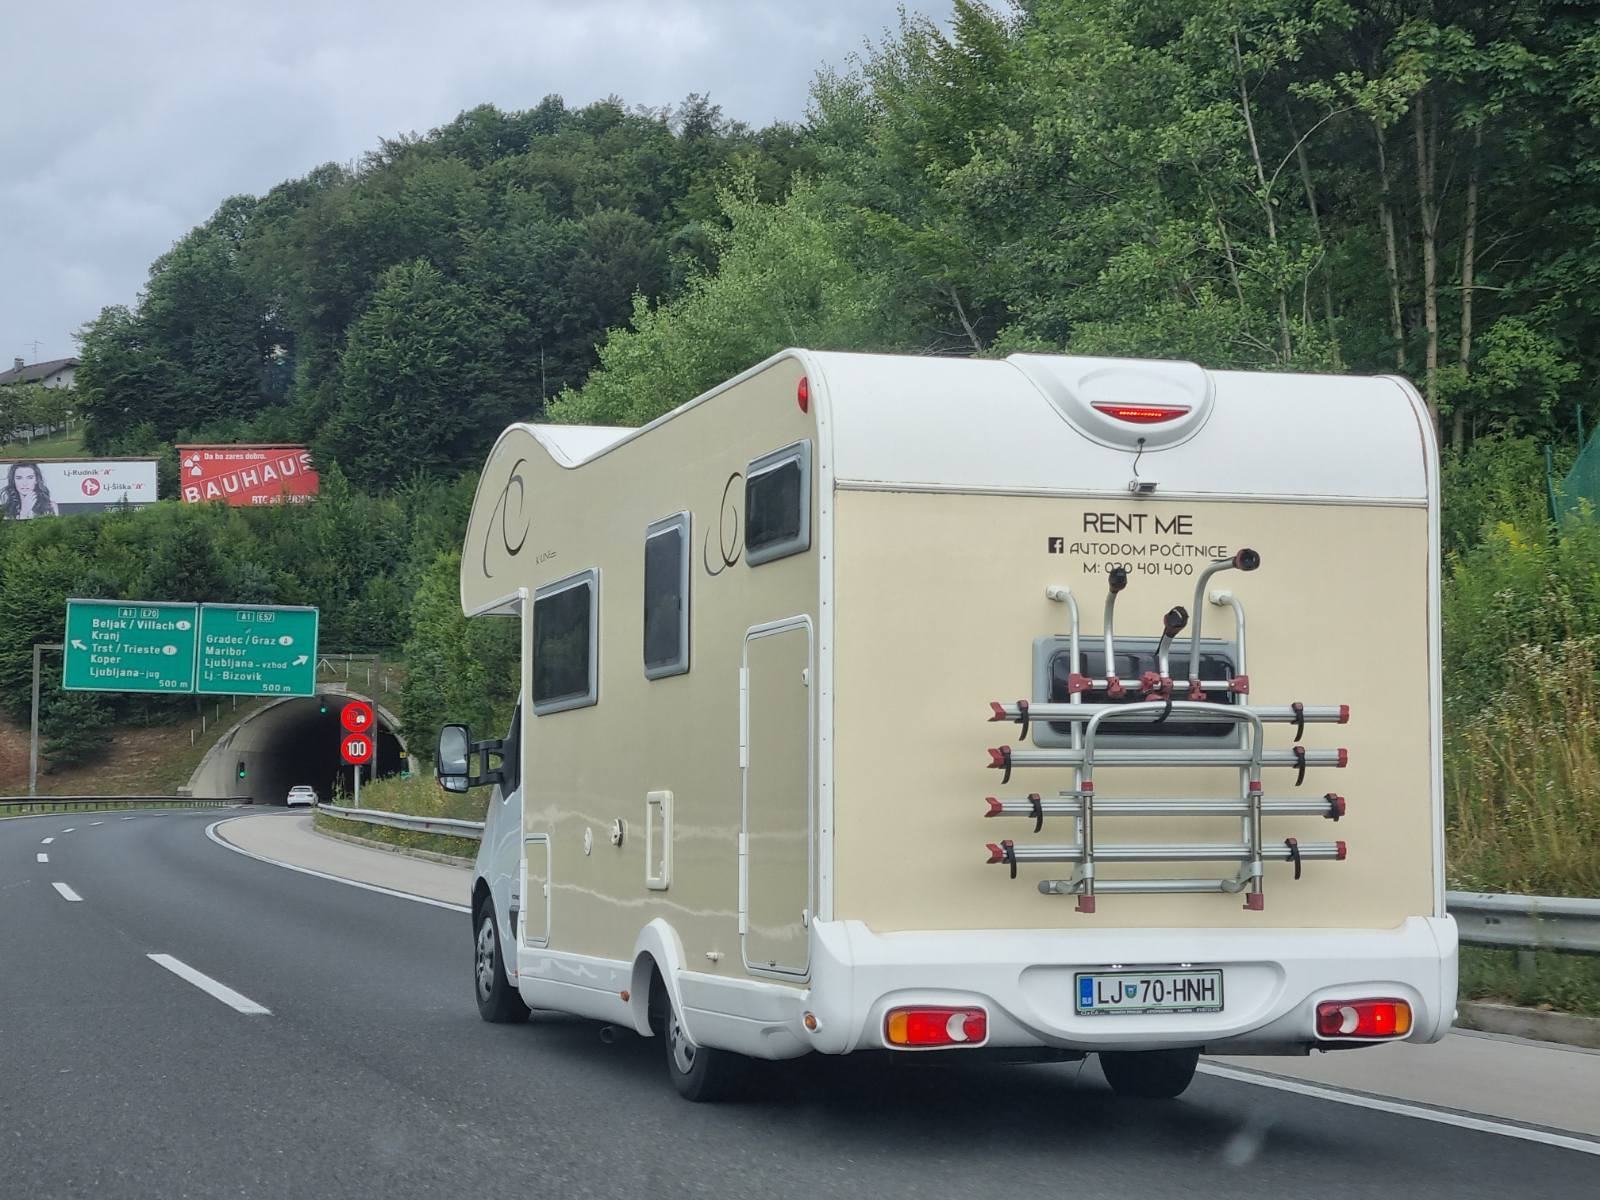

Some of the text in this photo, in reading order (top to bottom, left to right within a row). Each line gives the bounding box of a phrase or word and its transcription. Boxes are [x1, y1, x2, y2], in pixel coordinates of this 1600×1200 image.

[184, 453, 315, 504] BAUHAUS
[1083, 512, 1193, 535] RENT ME
[1069, 542, 1228, 558] AUTODOM POČITNICE
[1083, 562, 1100, 574] M:
[1137, 563, 1160, 575] 401
[1164, 563, 1193, 576] 400
[92, 619, 127, 630] Beljak
[137, 620, 175, 630] Villach
[91, 631, 120, 641] Kranj
[206, 635, 243, 644] Gradec
[252, 636, 276, 645] Graz
[92, 643, 113, 653] Trst
[123, 644, 161, 655] Trieste
[205, 646, 247, 656] Maribor
[90, 654, 121, 665] Koper
[159, 680, 177, 688] 500
[262, 684, 281, 692] 500
[347, 741, 366, 756] 100
[1097, 977, 1215, 1005] LJ 70-HNH
